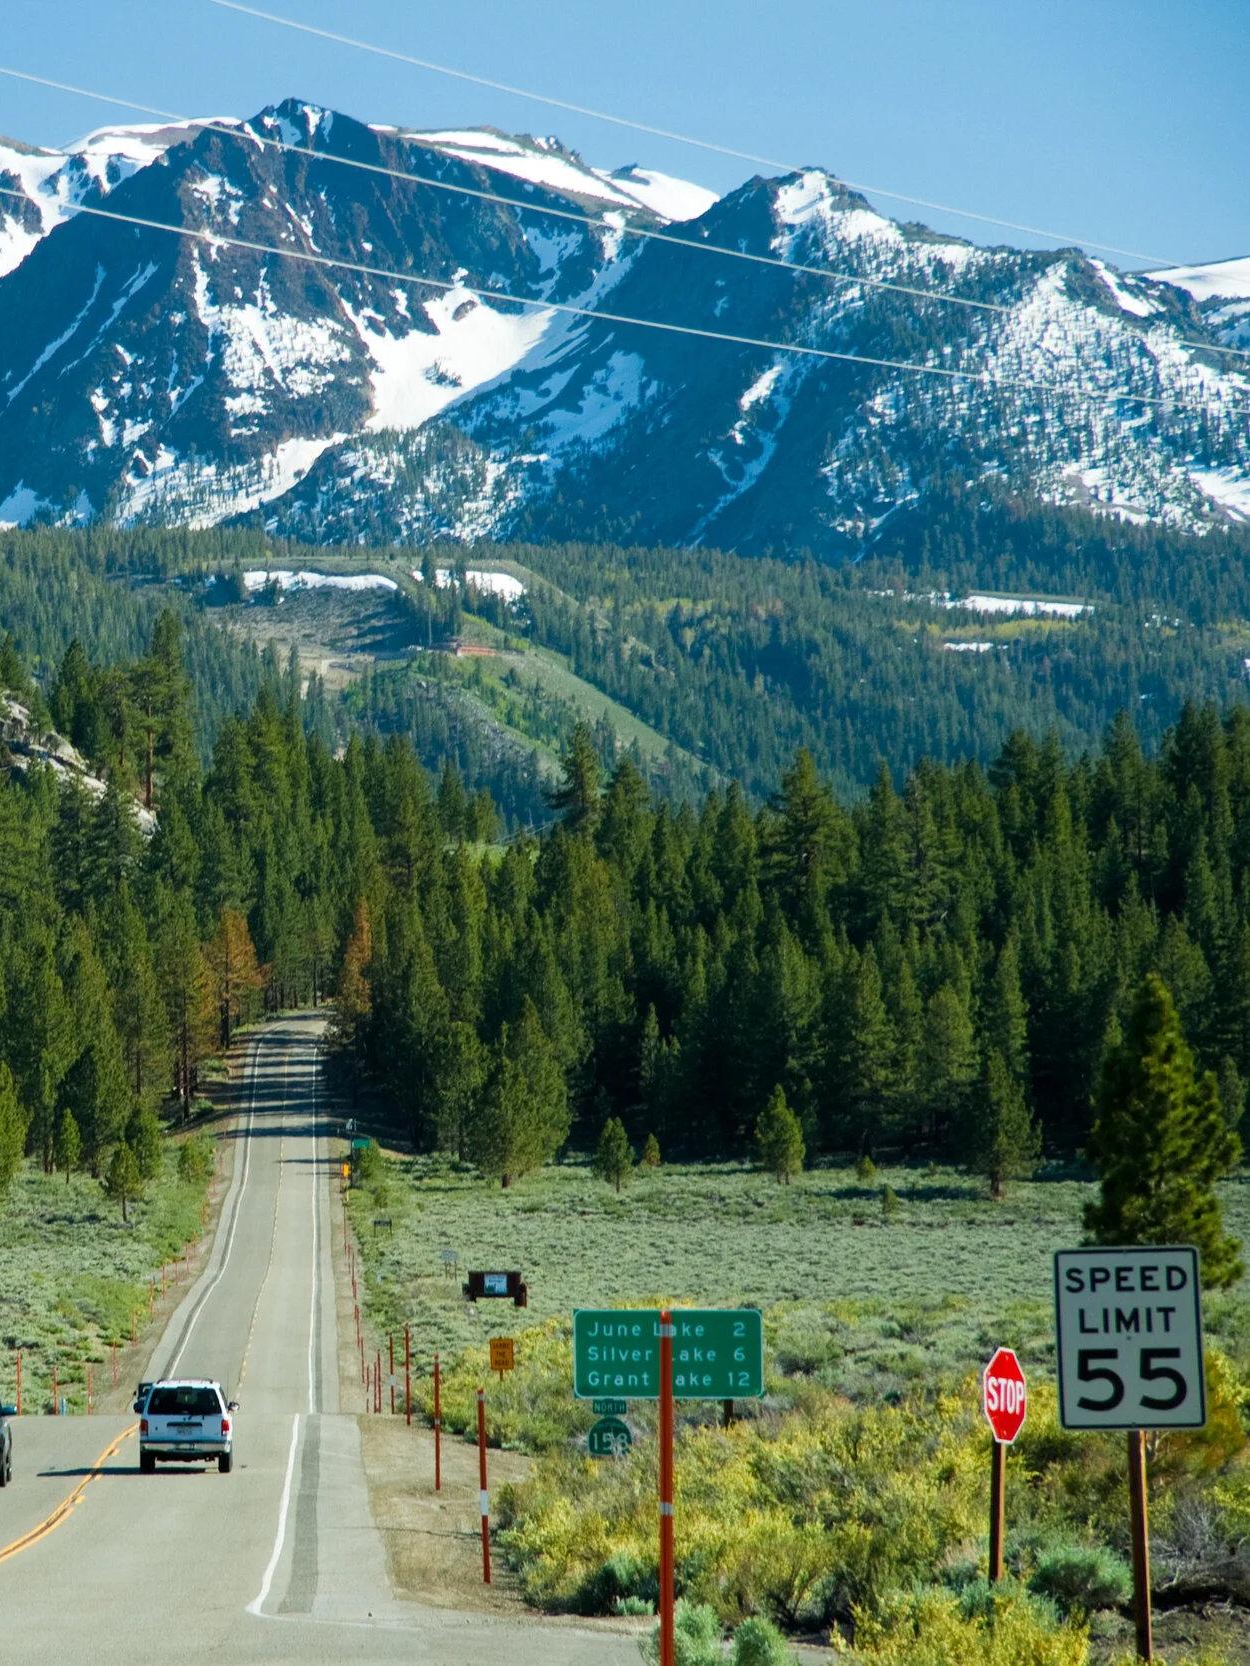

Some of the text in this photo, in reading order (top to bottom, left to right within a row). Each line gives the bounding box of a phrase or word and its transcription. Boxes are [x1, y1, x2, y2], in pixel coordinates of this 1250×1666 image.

[1065, 1265, 1188, 1293] SPEED
[587, 1321, 642, 1337] June
[733, 1321, 746, 1337] 2
[1079, 1307, 1176, 1334] LIMIT
[587, 1345, 746, 1362] Silver ake 6
[588, 1371, 750, 1387] Grant ake 12
[1077, 1347, 1188, 1411] 55
[987, 1376, 1025, 1415] STOP
[594, 1403, 625, 1412] NORTH
[593, 1432, 628, 1451] 158
